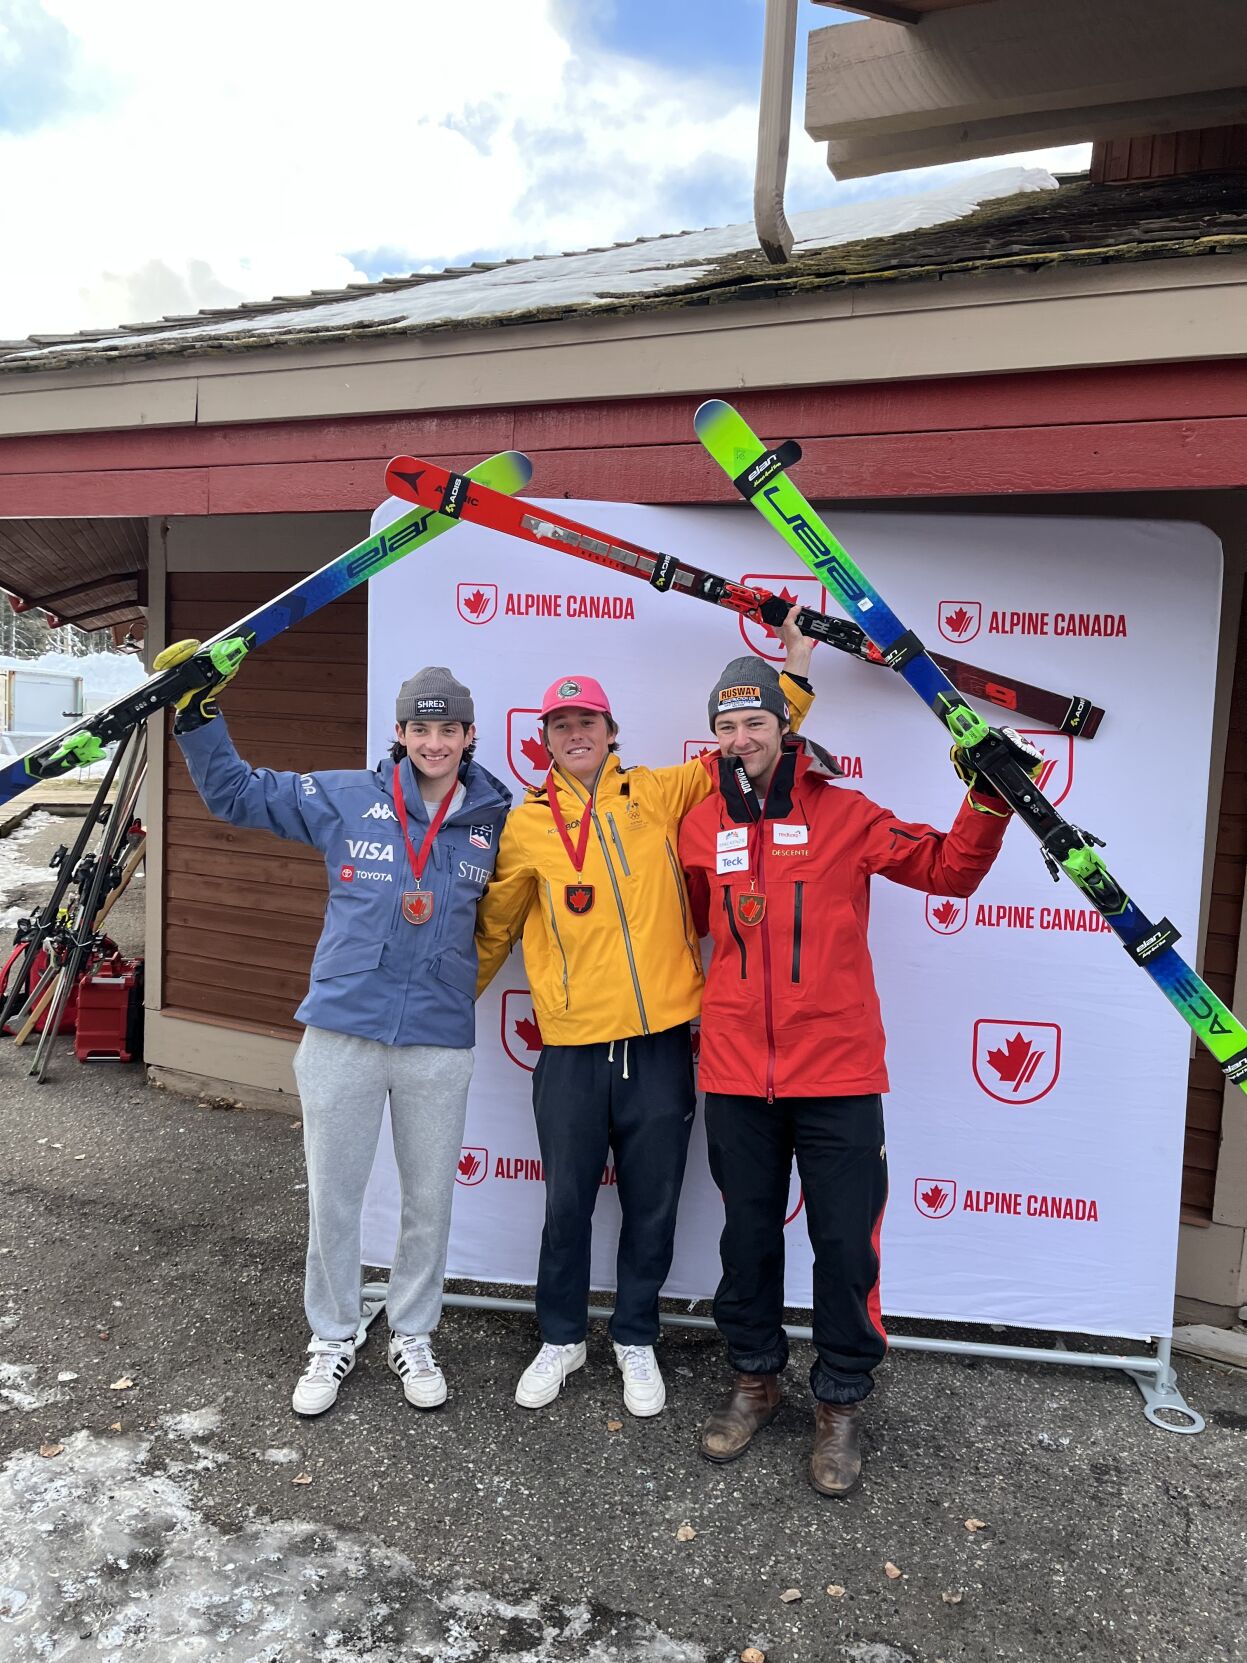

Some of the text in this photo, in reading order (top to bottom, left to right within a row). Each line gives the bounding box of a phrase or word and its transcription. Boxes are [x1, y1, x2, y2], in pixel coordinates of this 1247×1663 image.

[748, 453, 777, 482] elan
[504, 593, 635, 620] ALPINE CANADA
[988, 611, 1127, 638] ALPINE CANADA
[721, 687, 757, 699] RUSWAY
[736, 767, 752, 795] CANADA
[345, 839, 394, 862] VISA
[722, 856, 743, 867] Teck
[356, 870, 393, 882] TOYOTA
[975, 904, 1112, 933] ALPINE CANADA
[1136, 931, 1162, 952] elan
[963, 1190, 1099, 1222] ALPINE CANADA
